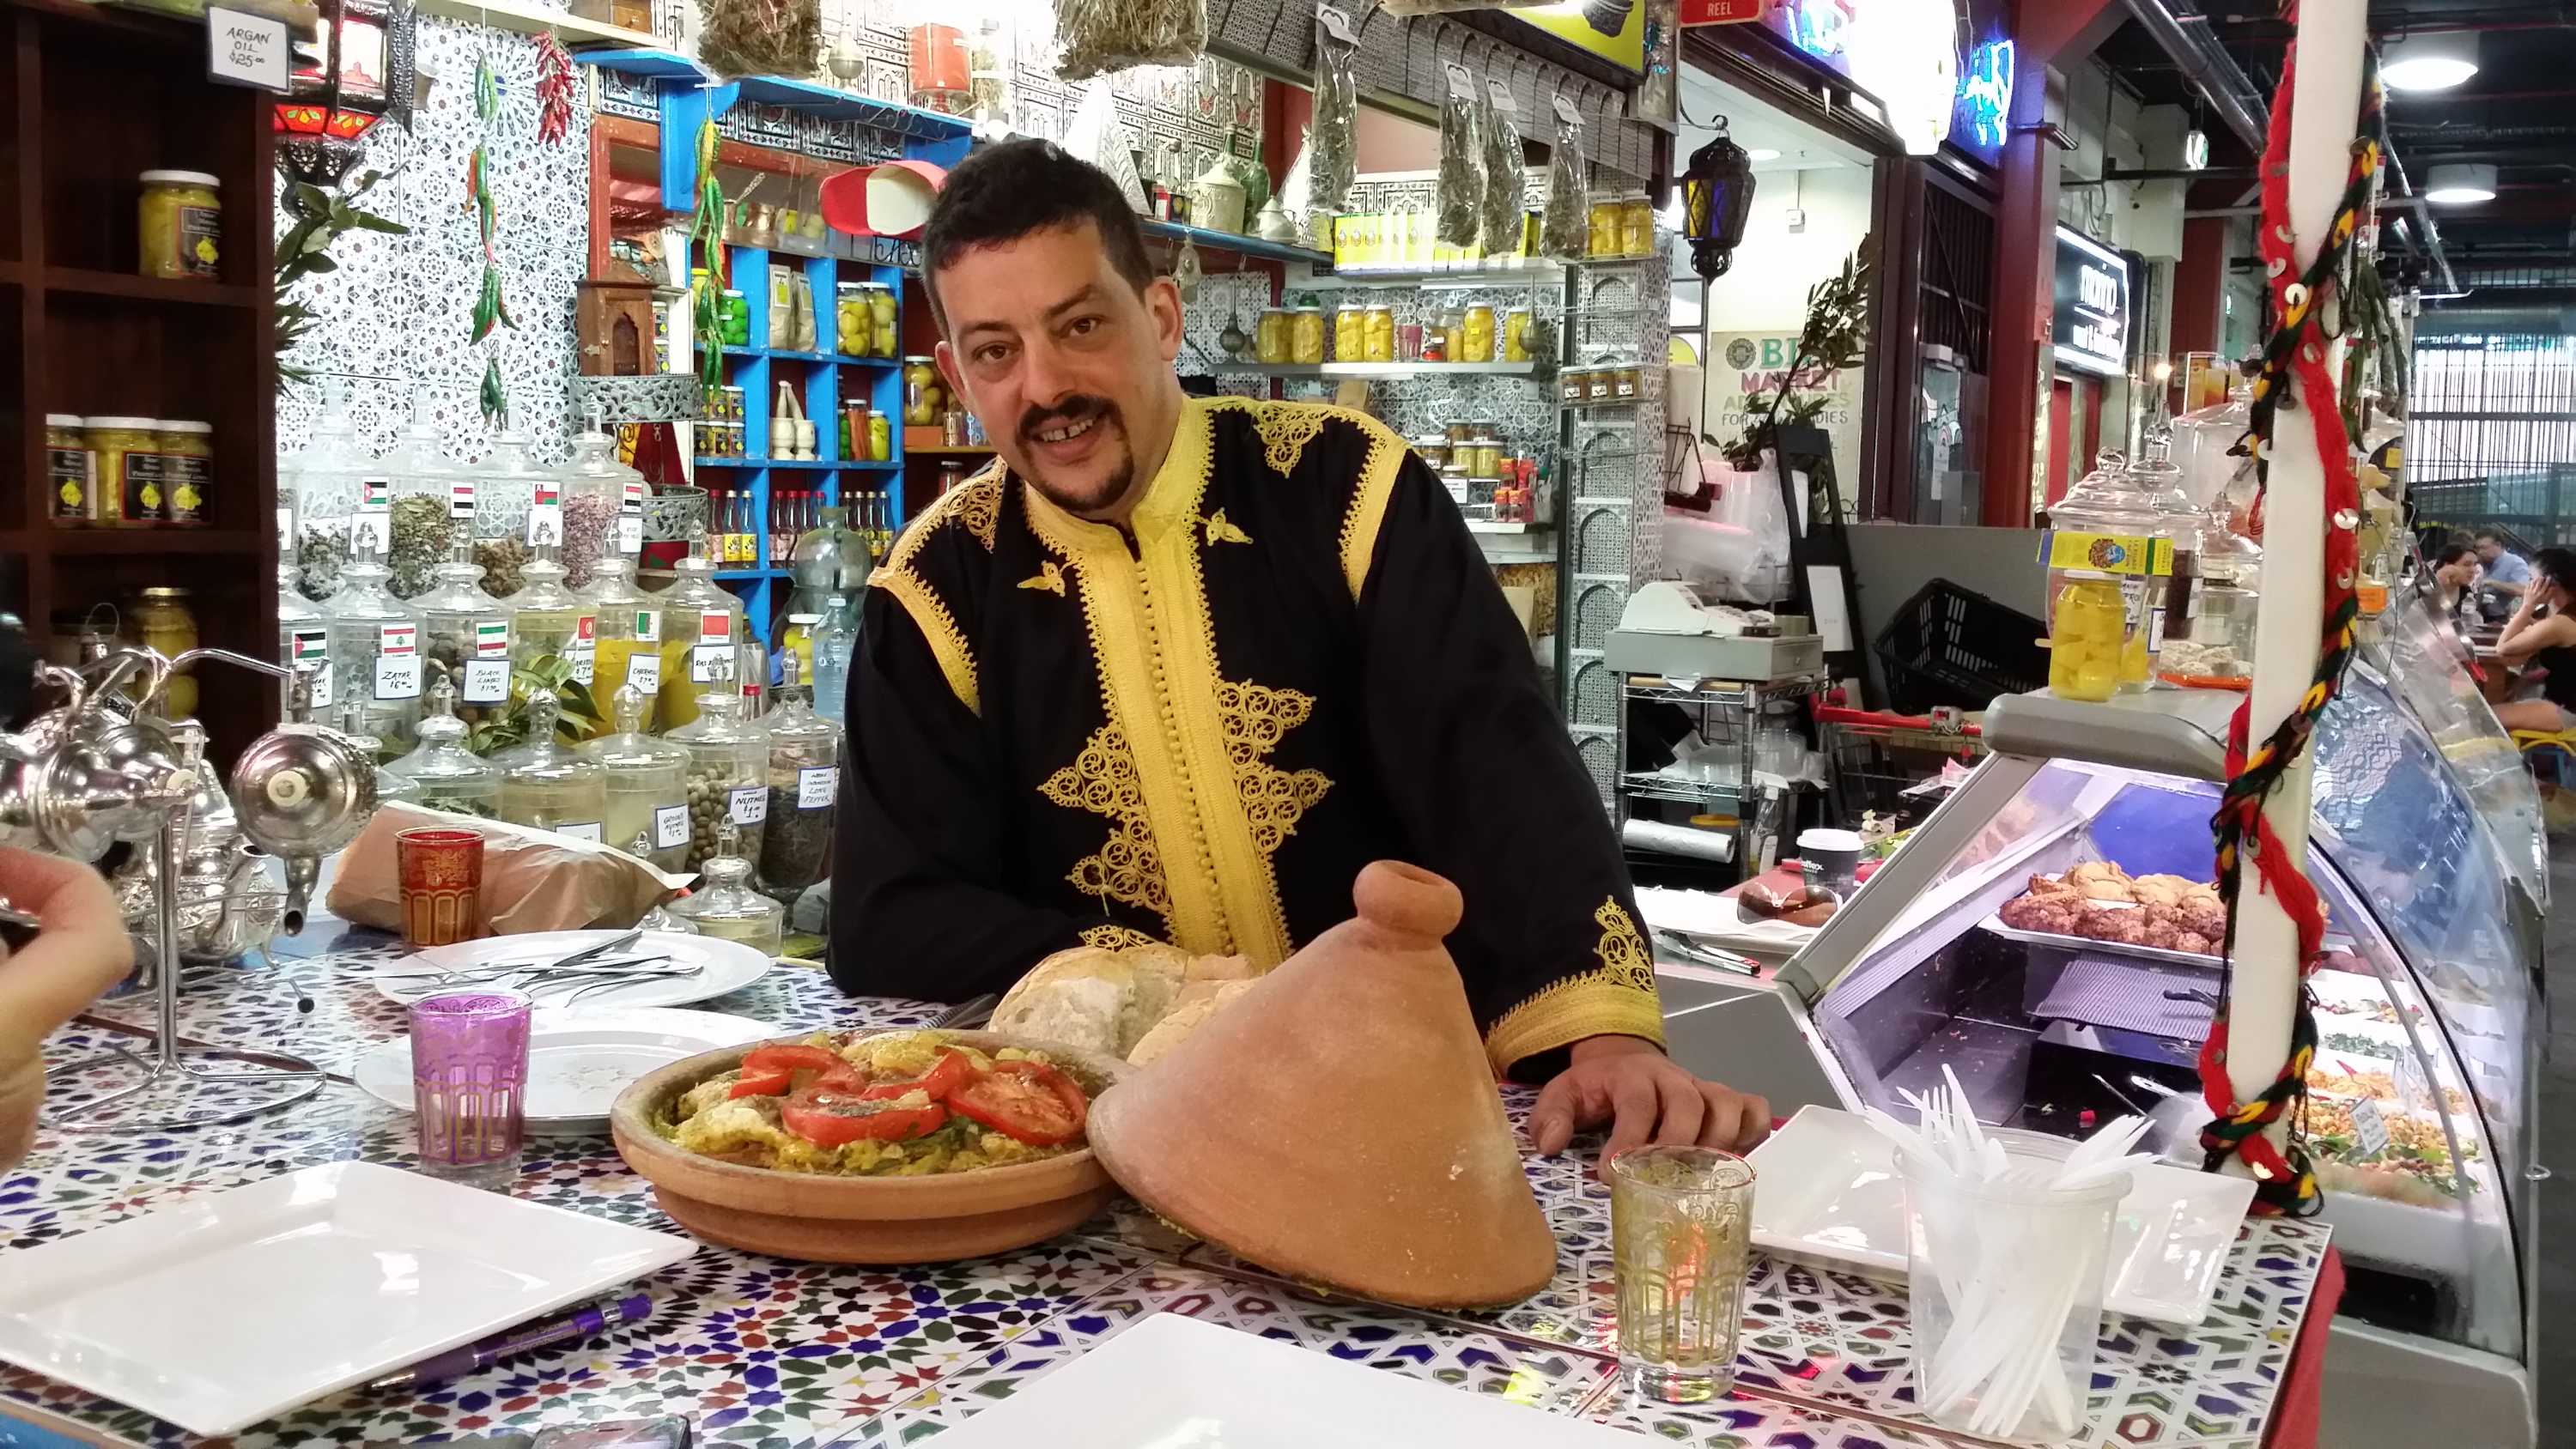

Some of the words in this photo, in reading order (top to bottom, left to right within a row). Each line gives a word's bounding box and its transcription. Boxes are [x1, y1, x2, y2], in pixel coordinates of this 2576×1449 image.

[1707, 3, 1733, 16] REEL
[226, 27, 271, 45] ARGAN
[234, 40, 260, 52] OIL
[1759, 337, 1812, 369] BI
[1722, 413, 1749, 426] FOR
